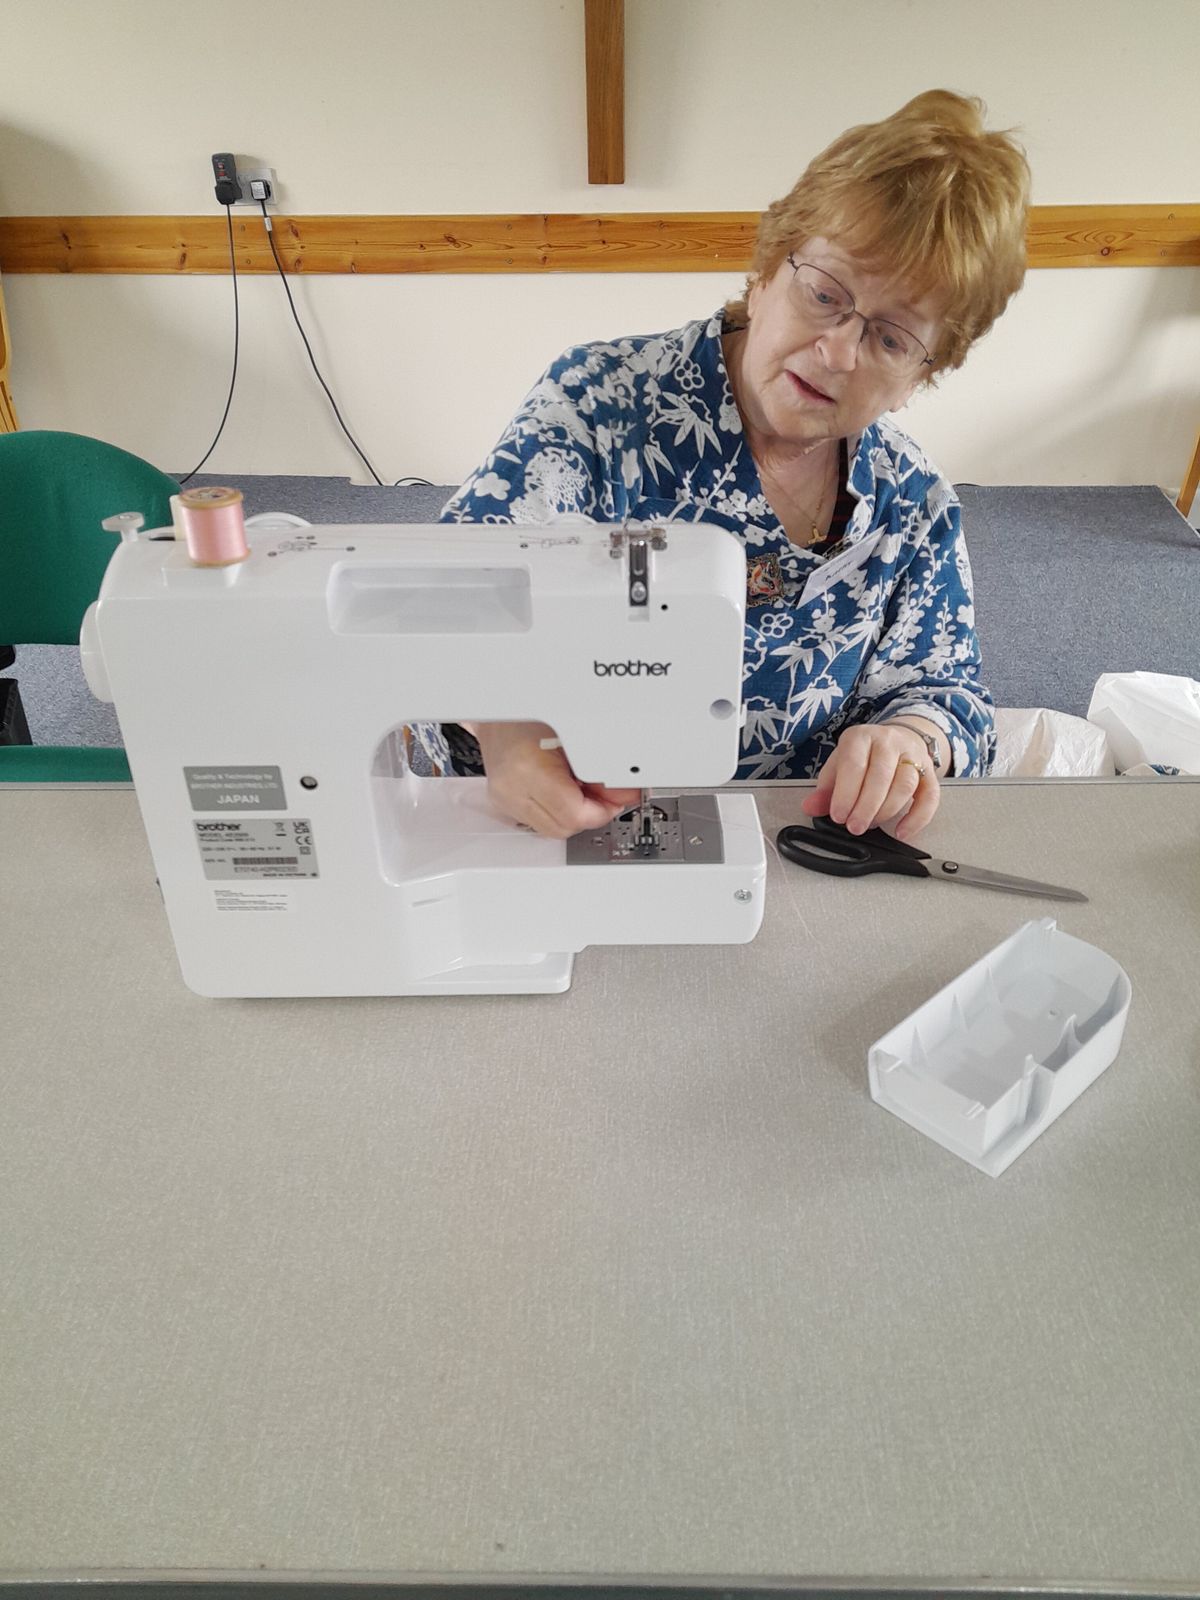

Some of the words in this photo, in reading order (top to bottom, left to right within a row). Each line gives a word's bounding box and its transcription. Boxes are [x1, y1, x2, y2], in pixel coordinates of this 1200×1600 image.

[593, 659, 672, 677] brother
[217, 794, 260, 804] JAPAN
[196, 822, 242, 831] brother
